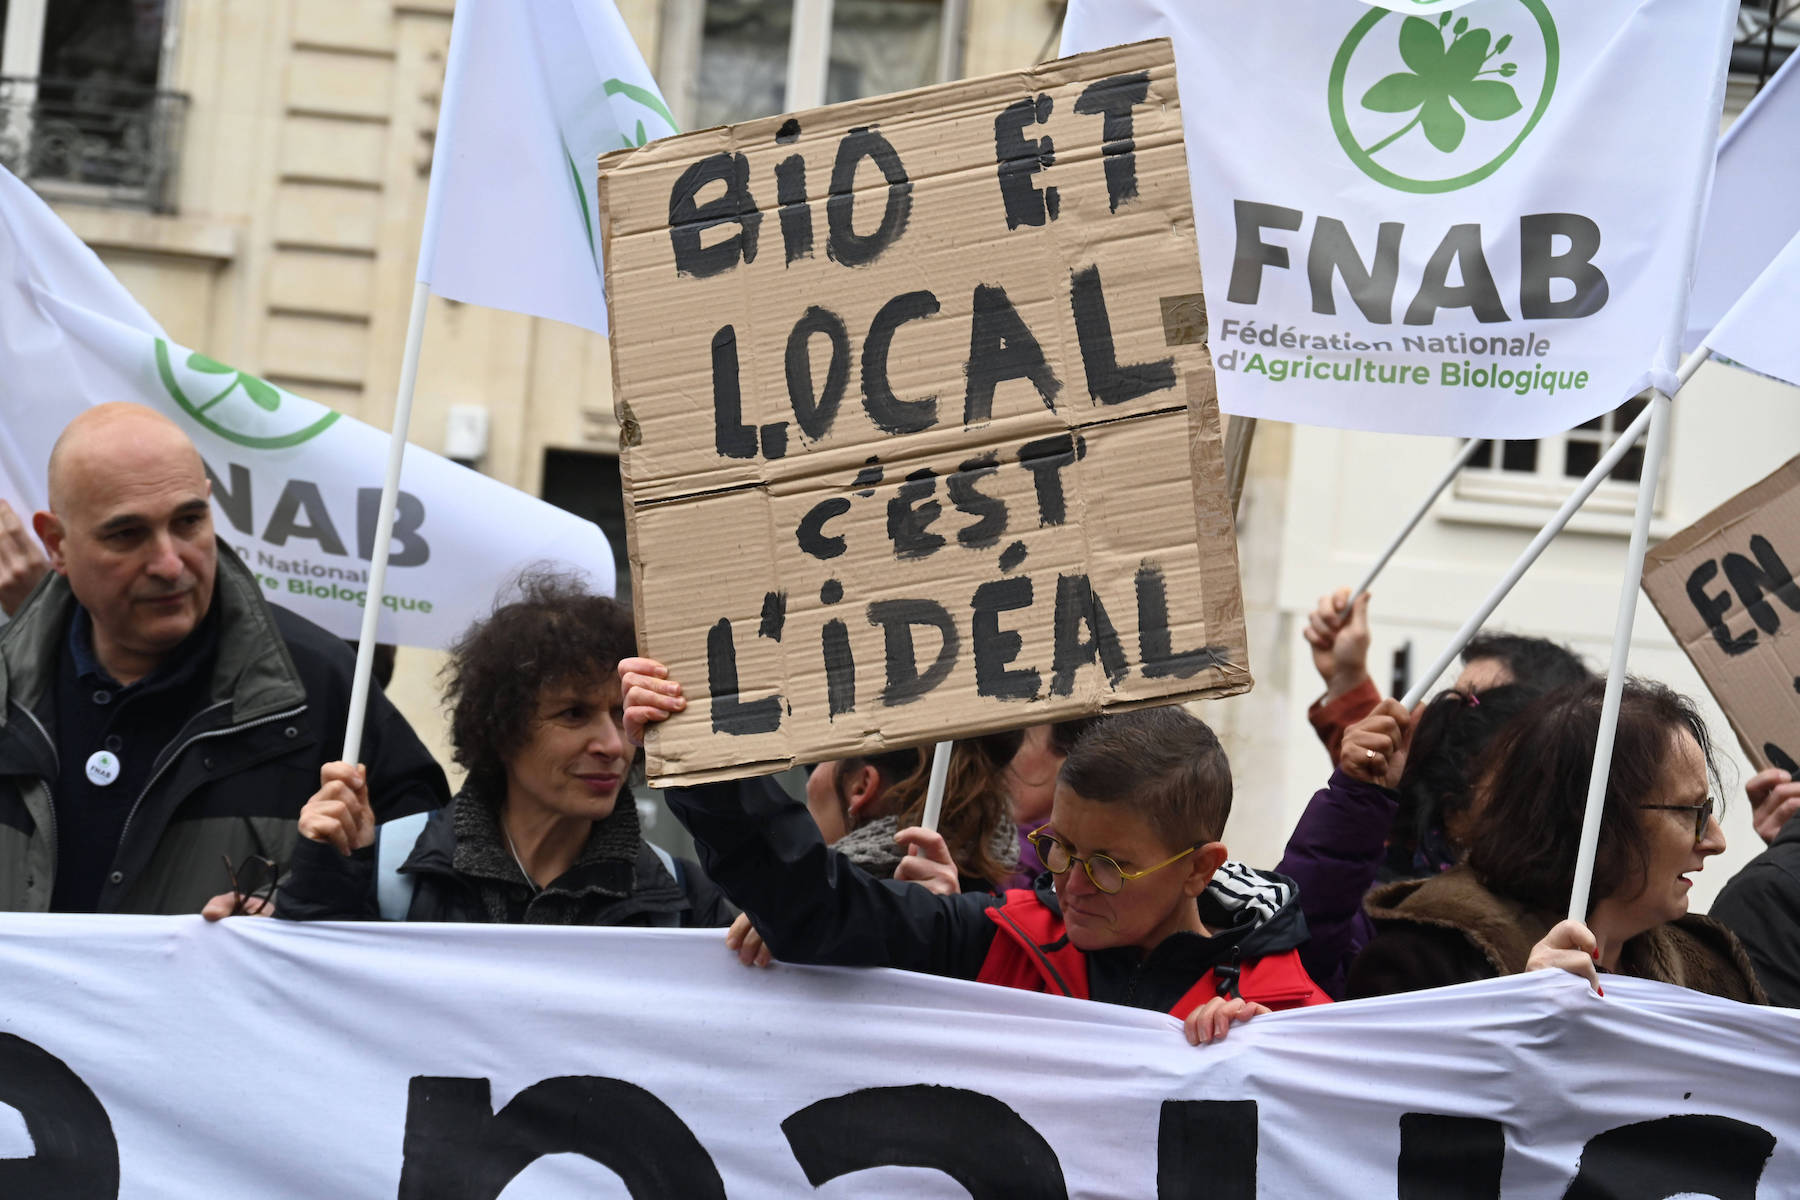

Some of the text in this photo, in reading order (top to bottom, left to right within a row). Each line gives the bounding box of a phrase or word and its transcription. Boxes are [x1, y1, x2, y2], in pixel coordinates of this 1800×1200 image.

[994, 70, 1151, 231] ET
[1226, 198, 1610, 326] FNAB
[711, 265, 1177, 460] LOCAL
[1217, 349, 1589, 396] d'Agriculture Biologique
[1220, 319, 1551, 357] Fédération Nationale
[201, 456, 430, 568] NAB
[258, 551, 370, 584] National
[287, 578, 433, 613] Biologque
